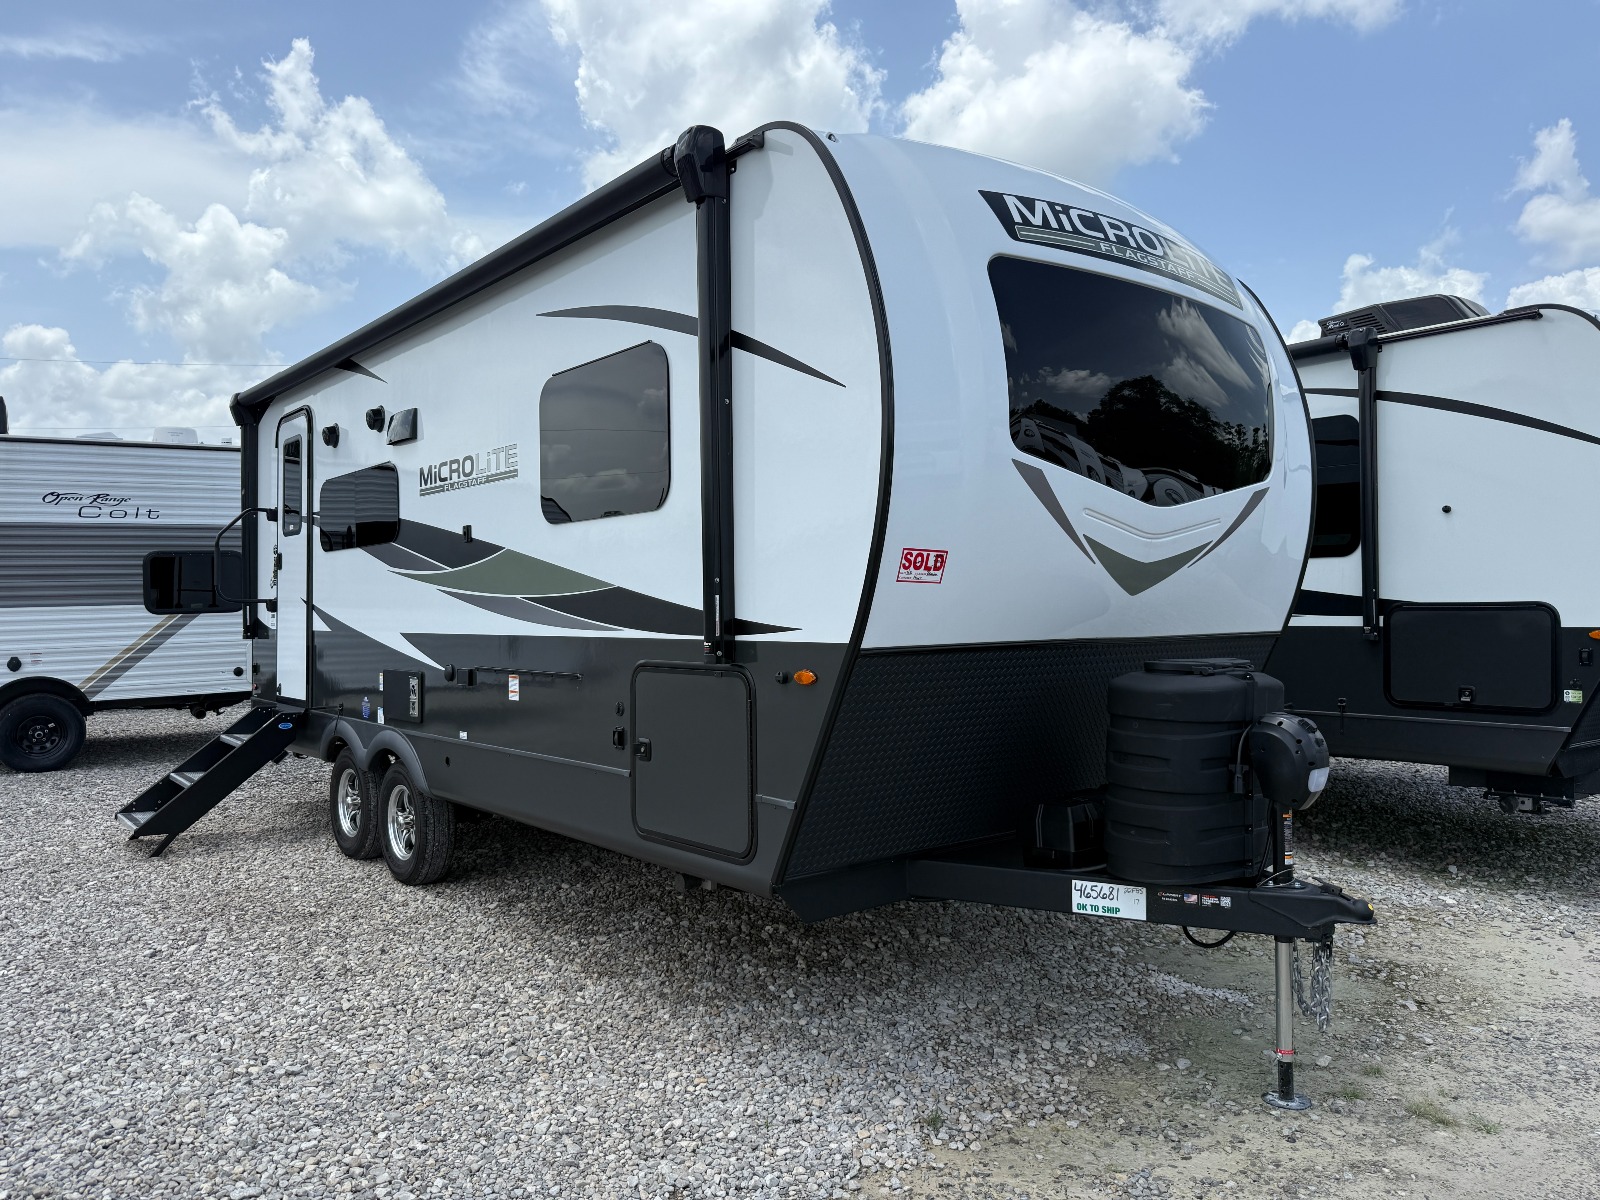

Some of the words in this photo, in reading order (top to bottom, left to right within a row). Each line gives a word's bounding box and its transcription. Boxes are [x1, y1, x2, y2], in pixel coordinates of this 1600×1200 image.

[1099, 243, 1196, 280] FLAGSTAFF
[444, 477, 487, 492] FLAGSTAFF
[42, 491, 84, 506] Open
[86, 493, 131, 507] Range
[78, 505, 160, 520] Colt
[902, 551, 945, 572] SOLD
[1074, 881, 1120, 901] 465681
[1076, 902, 1088, 912] OK
[1089, 904, 1100, 913] TO
[1101, 905, 1121, 915] SHIP
